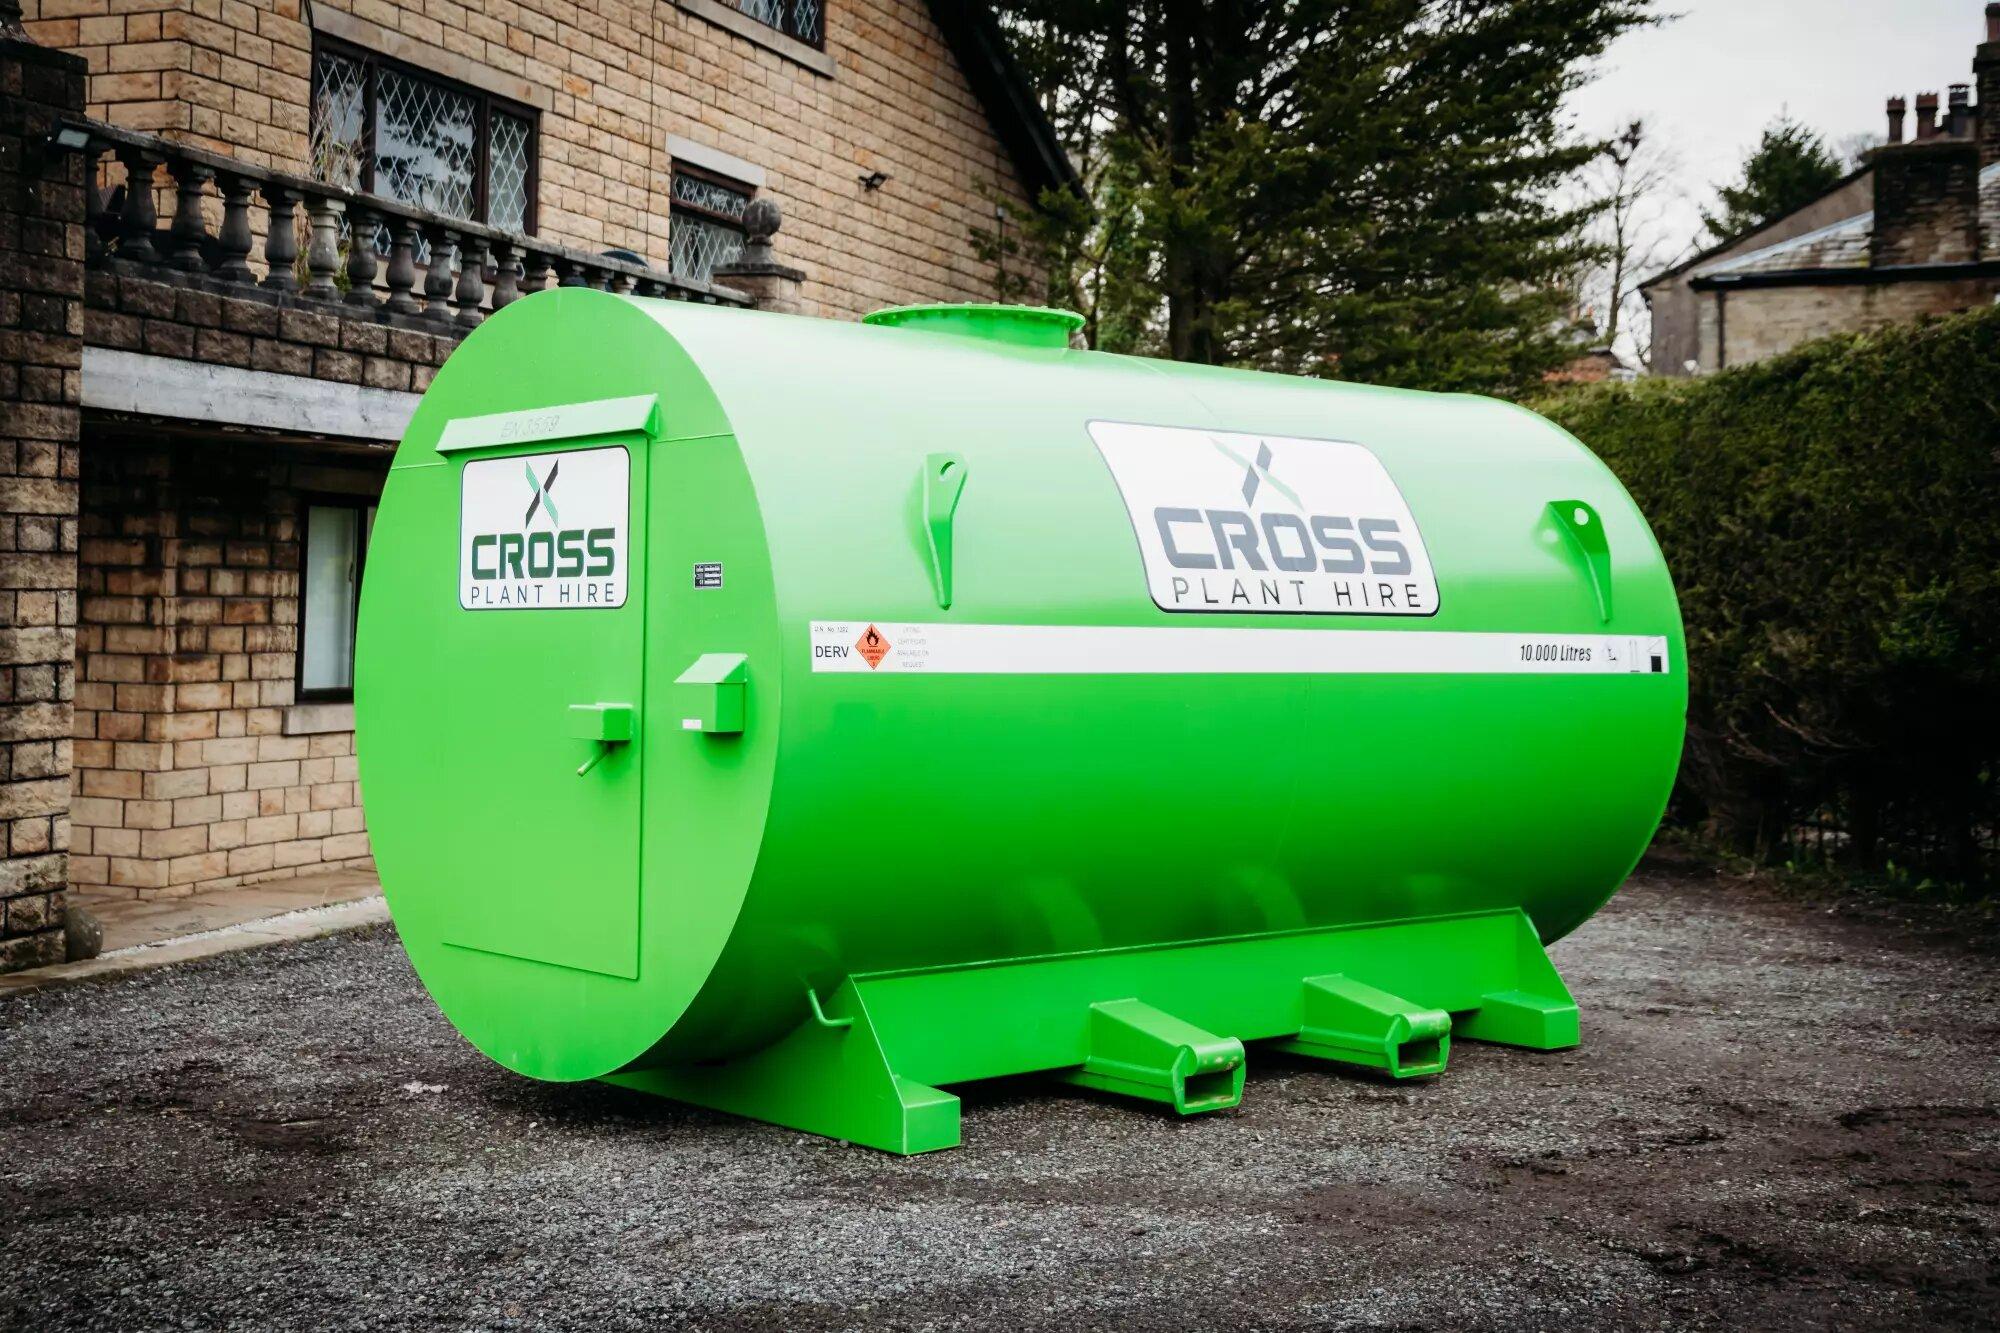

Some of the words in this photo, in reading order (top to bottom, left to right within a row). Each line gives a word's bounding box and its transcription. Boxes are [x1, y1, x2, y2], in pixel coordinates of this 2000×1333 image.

[471, 527, 616, 580] CROSS
[1153, 506, 1412, 576] CROSS
[471, 585, 543, 604] PLANT
[560, 583, 615, 603] HIRE
[1171, 576, 1305, 606] PLANT
[1333, 580, 1422, 608] HIRE
[815, 645, 849, 658] DERV
[1560, 644, 1592, 661] Litres
